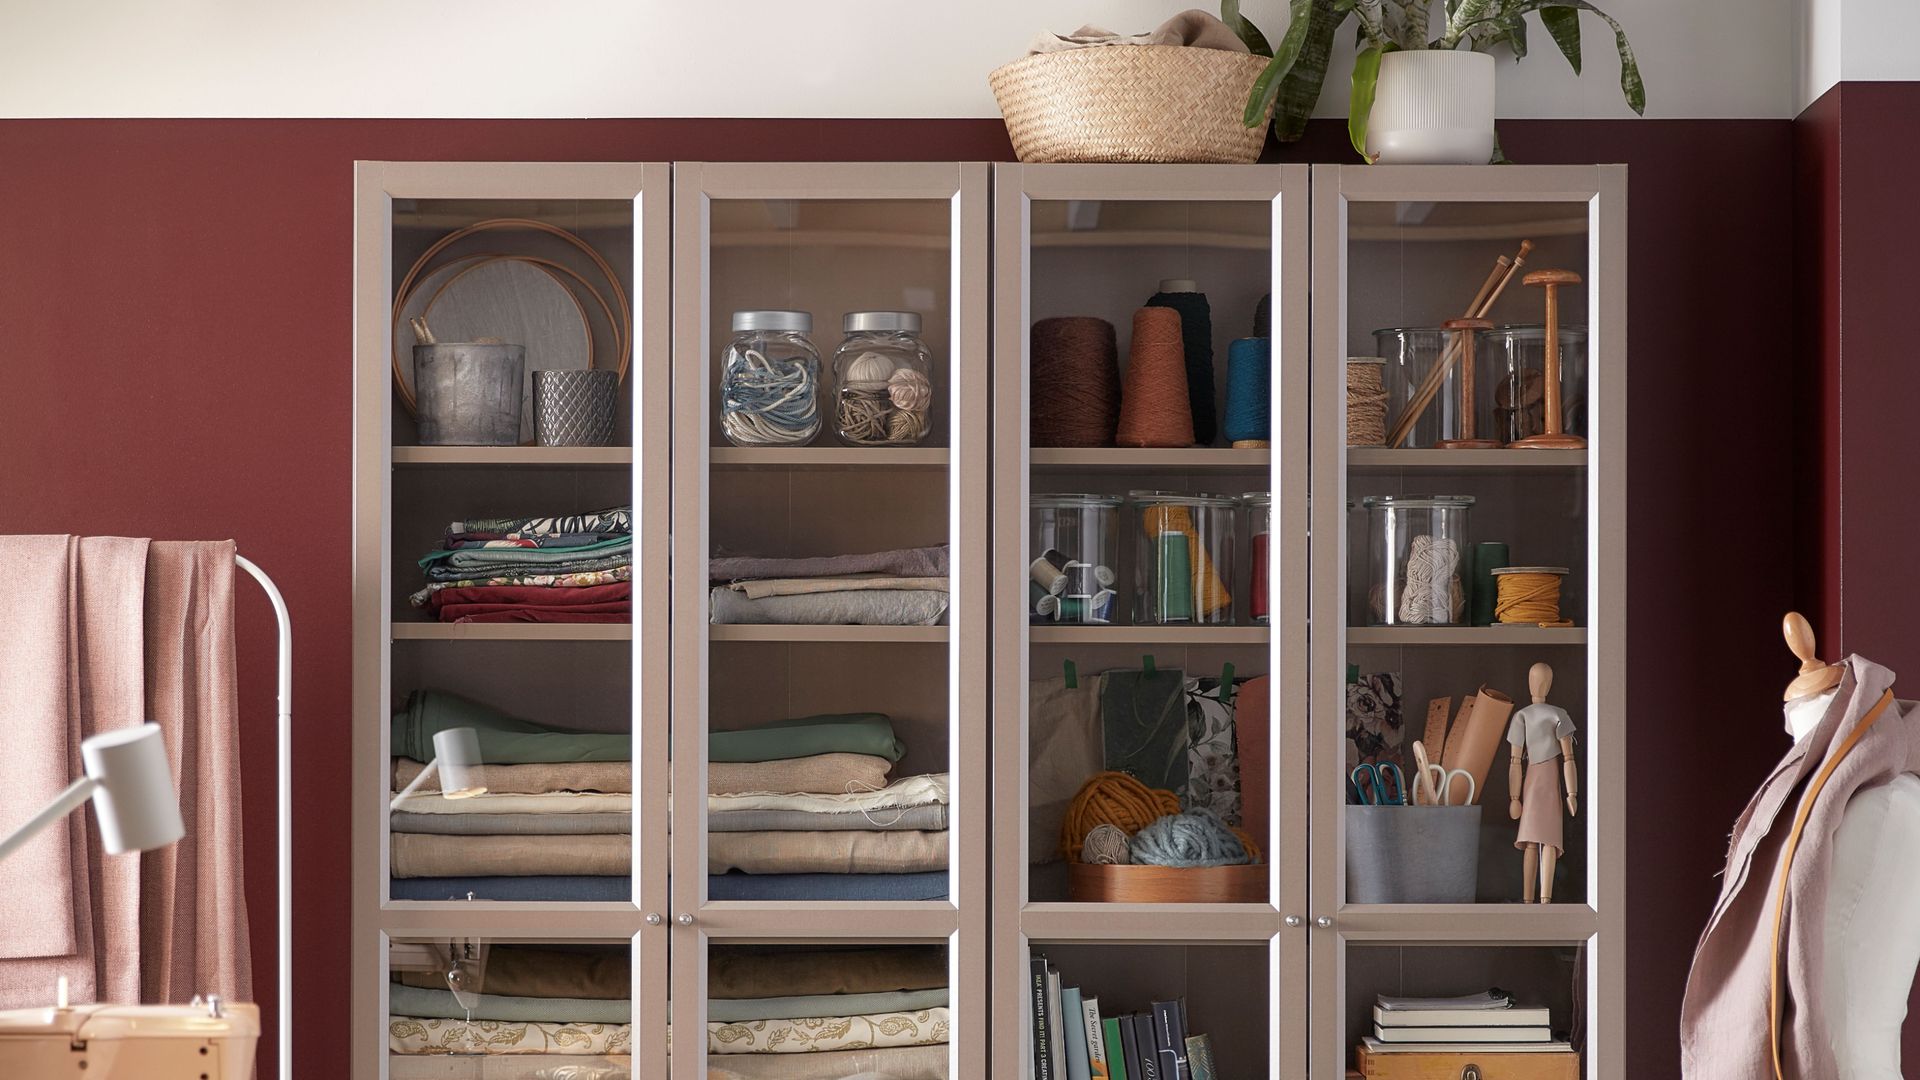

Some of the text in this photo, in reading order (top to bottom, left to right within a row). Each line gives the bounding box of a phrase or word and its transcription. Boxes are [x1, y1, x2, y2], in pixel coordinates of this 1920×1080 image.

[1036, 989, 1044, 1017] PRESENTS
[1090, 1020, 1098, 1040] Secret
[1091, 1040, 1101, 1063] garden
